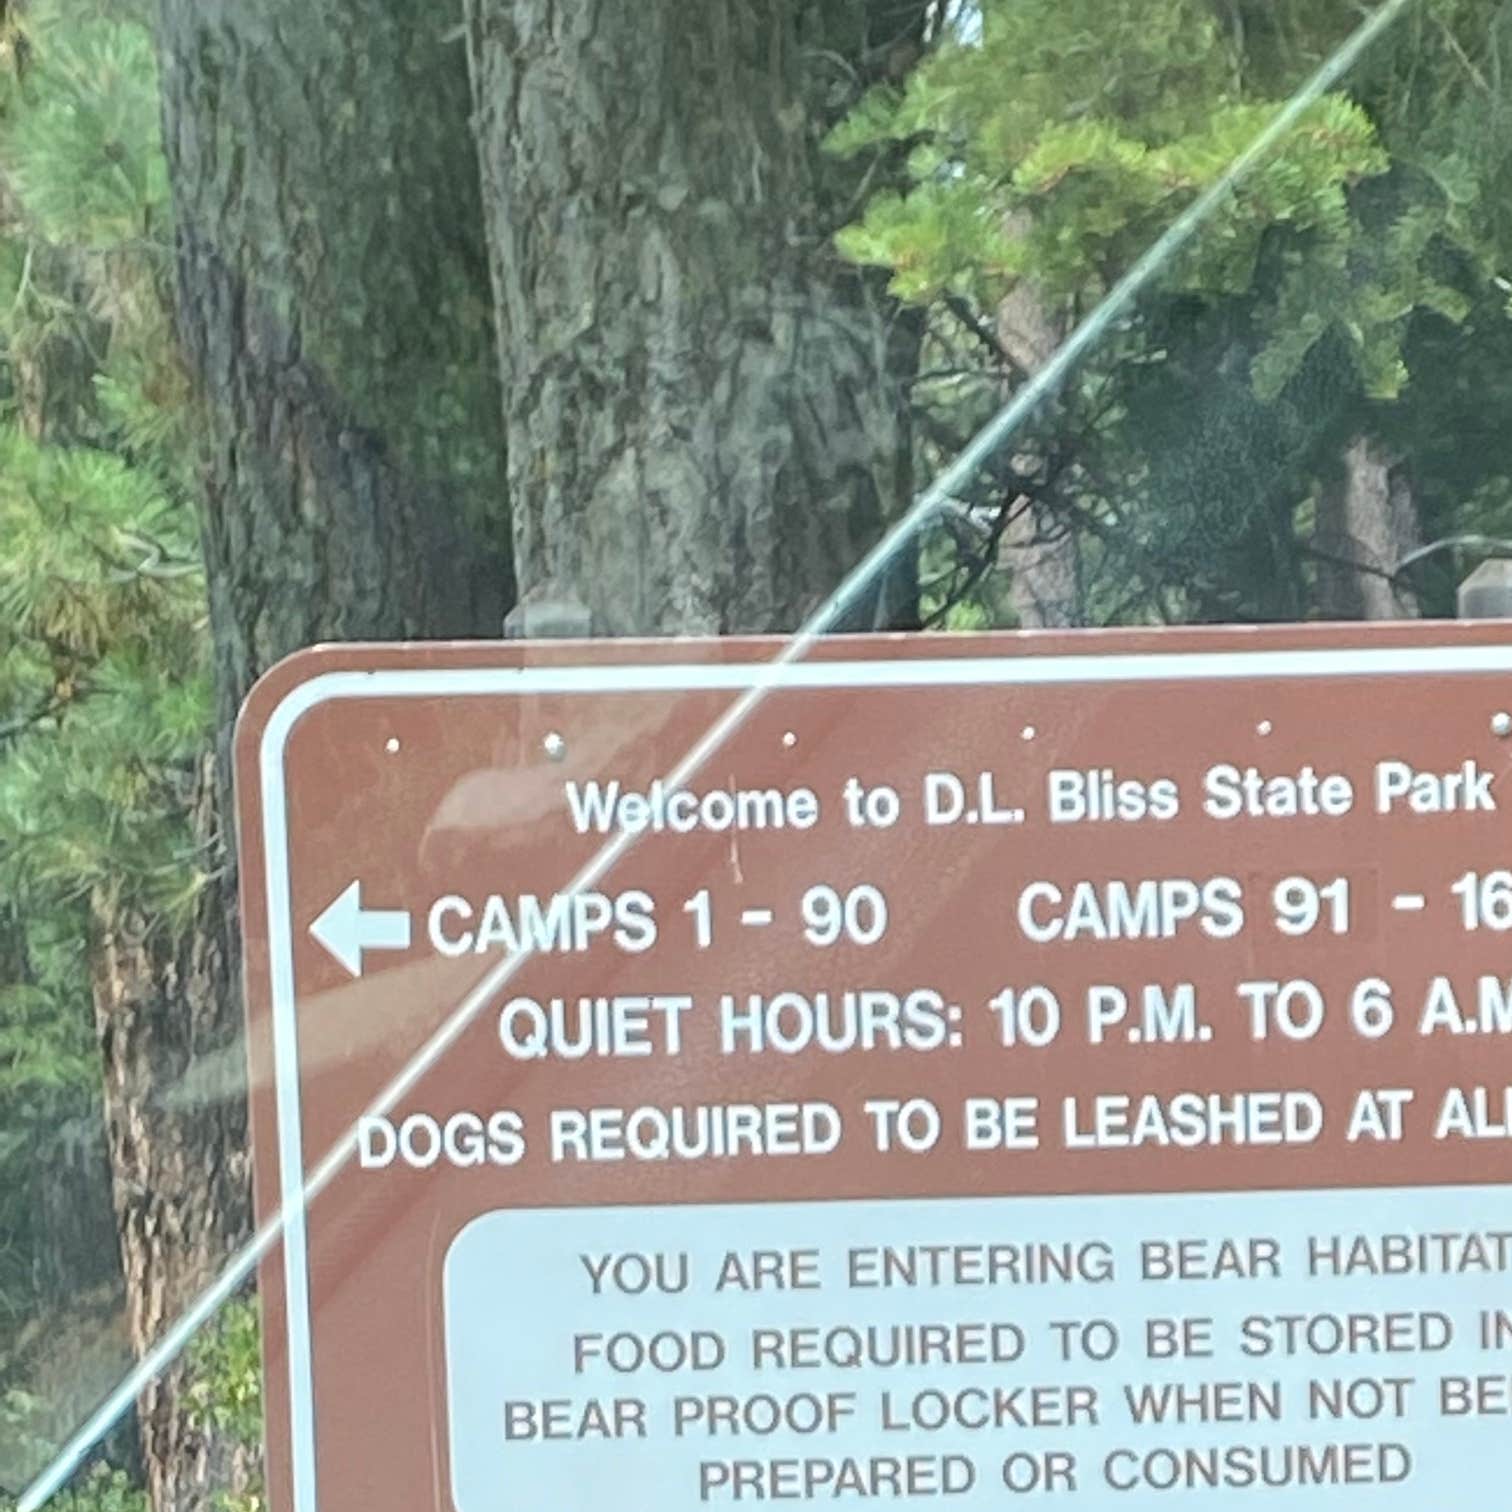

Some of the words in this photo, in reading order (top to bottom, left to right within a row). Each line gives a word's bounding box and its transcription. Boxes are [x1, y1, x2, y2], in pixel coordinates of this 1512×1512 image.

[566, 777, 818, 833] Welcome
[844, 780, 899, 825] to
[925, 773, 1025, 823] D.L.
[1049, 770, 1179, 821] Bliss
[1203, 765, 1353, 817] State
[1378, 761, 1496, 813] Park
[428, 890, 656, 956] CAMPS
[684, 890, 711, 946] 1
[741, 909, 771, 925] -
[802, 885, 886, 945] 90
[1017, 877, 1243, 943] CAMPS
[1273, 877, 1350, 935] 91
[1392, 893, 1425, 910] -
[500, 995, 692, 1061] QUIET
[720, 988, 961, 1053] HOURS:
[988, 985, 1060, 1047] 10
[1088, 983, 1212, 1044] P.M.
[1238, 979, 1323, 1039] TO
[1351, 978, 1394, 1037] 6
[357, 1113, 524, 1169] DOGS
[551, 1102, 841, 1163] REQUIRED
[865, 1098, 940, 1153] TO
[965, 1097, 1039, 1150] BE
[1064, 1092, 1322, 1149] LEASHED
[1347, 1088, 1413, 1142] AT
[580, 1252, 688, 1296] YOU
[715, 1248, 821, 1293] ARE
[848, 1240, 1114, 1289] ENTERING
[1141, 1237, 1280, 1281] BEAR
[574, 1331, 725, 1375] FOOD
[752, 1323, 1024, 1370] REQUIRED
[1049, 1320, 1118, 1361] TO
[1145, 1317, 1214, 1360] BE
[1240, 1311, 1452, 1357] STORED
[504, 1398, 647, 1441] BEAR
[674, 1392, 856, 1437] PROOF
[881, 1385, 1098, 1432] LOCKER
[1125, 1381, 1281, 1425] WHEN
[1308, 1377, 1415, 1422] NOT
[699, 1454, 975, 1502] PREPARED
[1002, 1452, 1077, 1494] OR
[1104, 1442, 1412, 1491] CONSUMED
